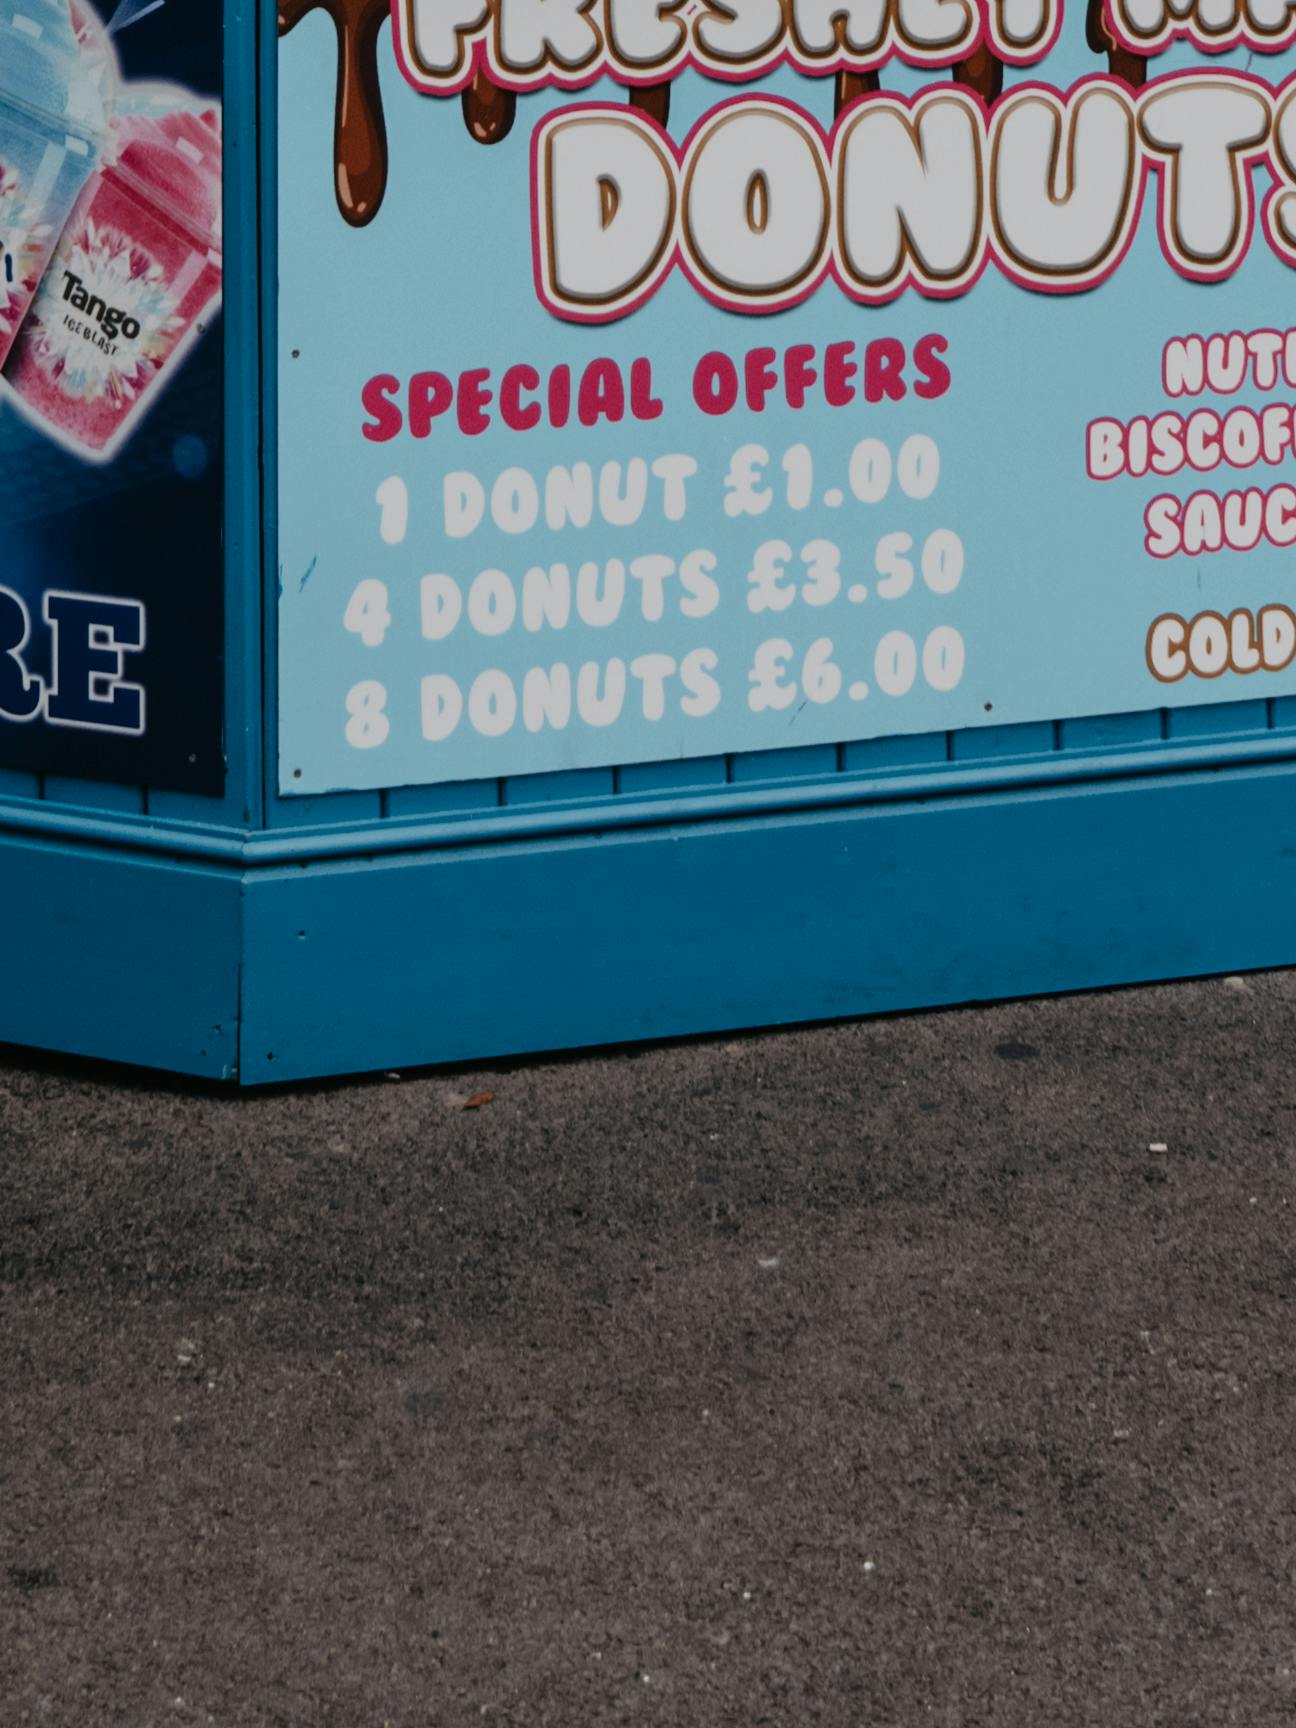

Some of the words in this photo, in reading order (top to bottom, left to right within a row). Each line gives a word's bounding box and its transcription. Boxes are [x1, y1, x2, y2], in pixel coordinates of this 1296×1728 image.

[62, 270, 140, 340] Tango
[63, 315, 83, 336] ICE
[83, 329, 118, 356] BLAST
[360, 358, 663, 443] SPECIAL
[692, 333, 952, 419] OFFERS
[374, 476, 409, 544] 1
[444, 452, 699, 537] DONUT
[723, 434, 941, 519] £1.00
[344, 576, 390, 647] 4
[421, 551, 721, 638] DONUTS
[745, 528, 965, 615] £3.50
[344, 678, 388, 748] 8
[421, 647, 721, 741] DONUTS
[745, 625, 965, 713] £6.00
